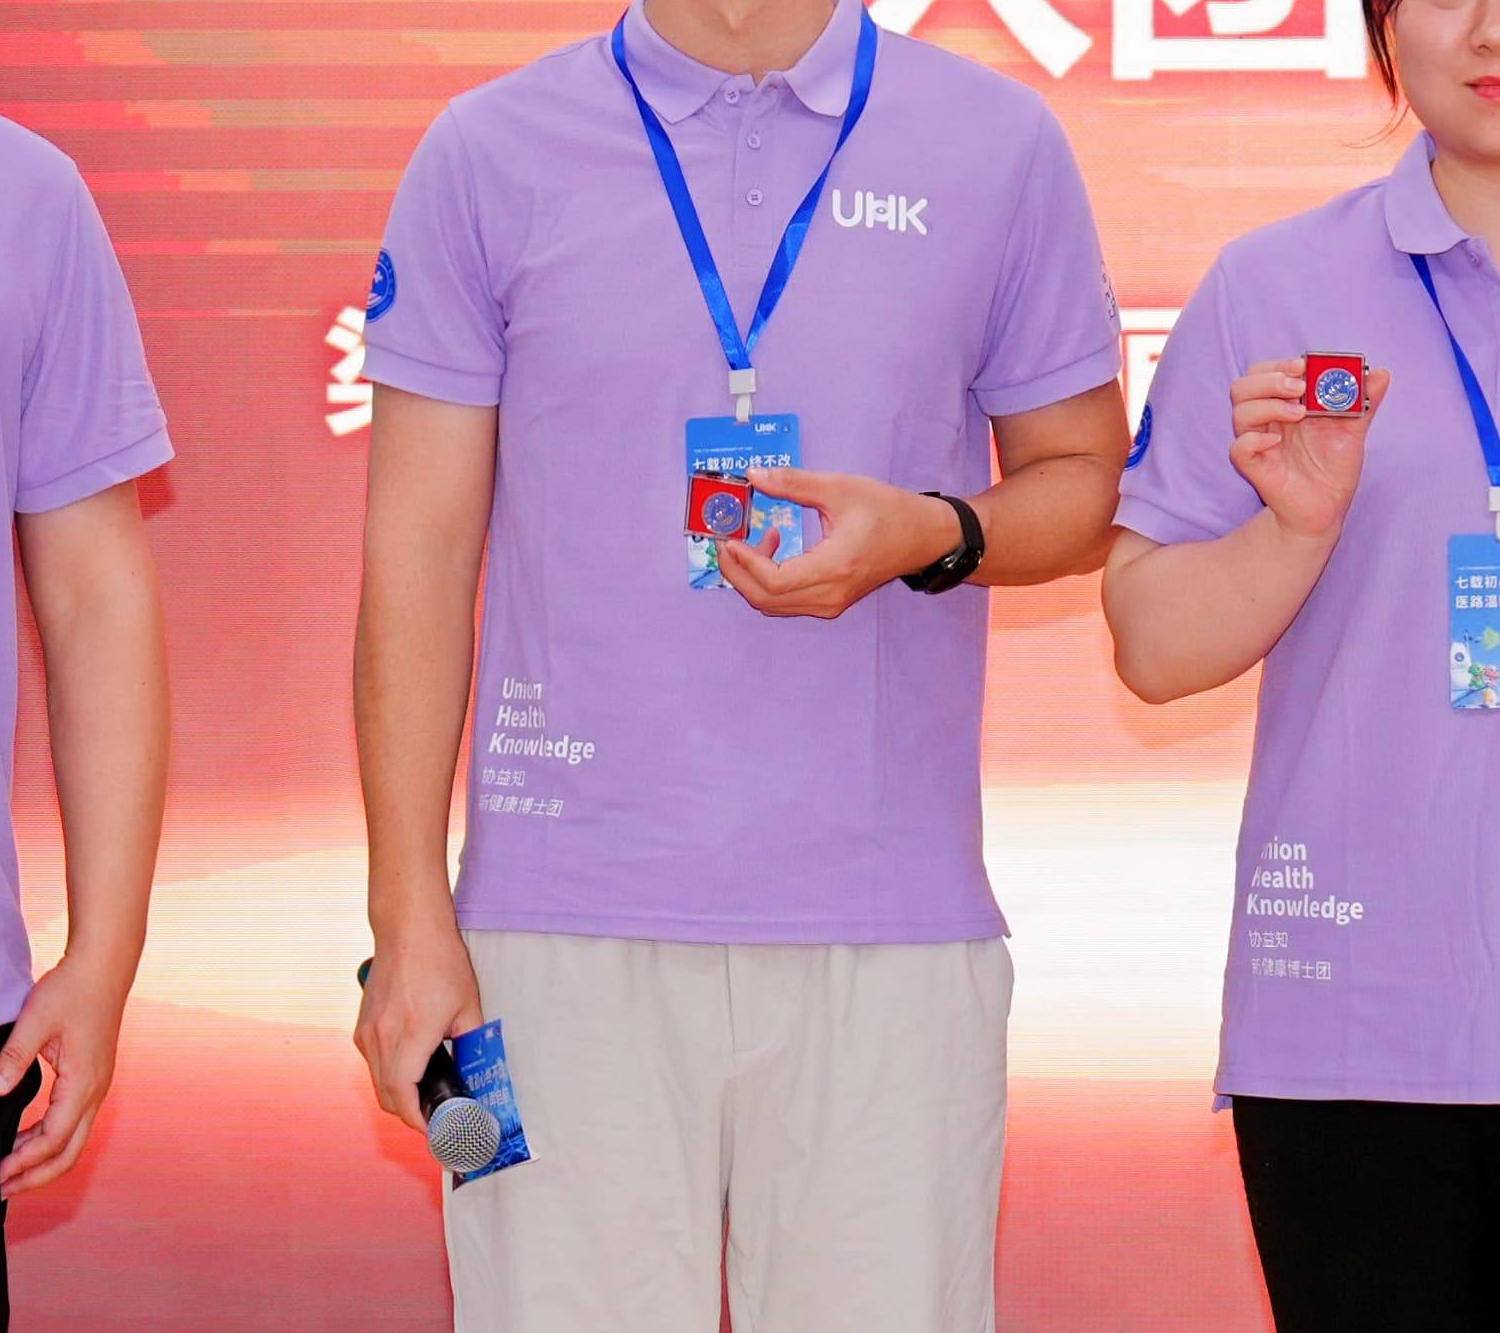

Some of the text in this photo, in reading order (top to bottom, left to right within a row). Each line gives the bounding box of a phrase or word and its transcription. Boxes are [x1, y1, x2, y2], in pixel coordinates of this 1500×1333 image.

[832, 189, 928, 235] UHK
[502, 677, 542, 700] Union
[496, 704, 545, 728] Health
[488, 732, 595, 764] Knowledge
[1260, 835, 1307, 861] nion
[1246, 893, 1364, 925] Knowledge
